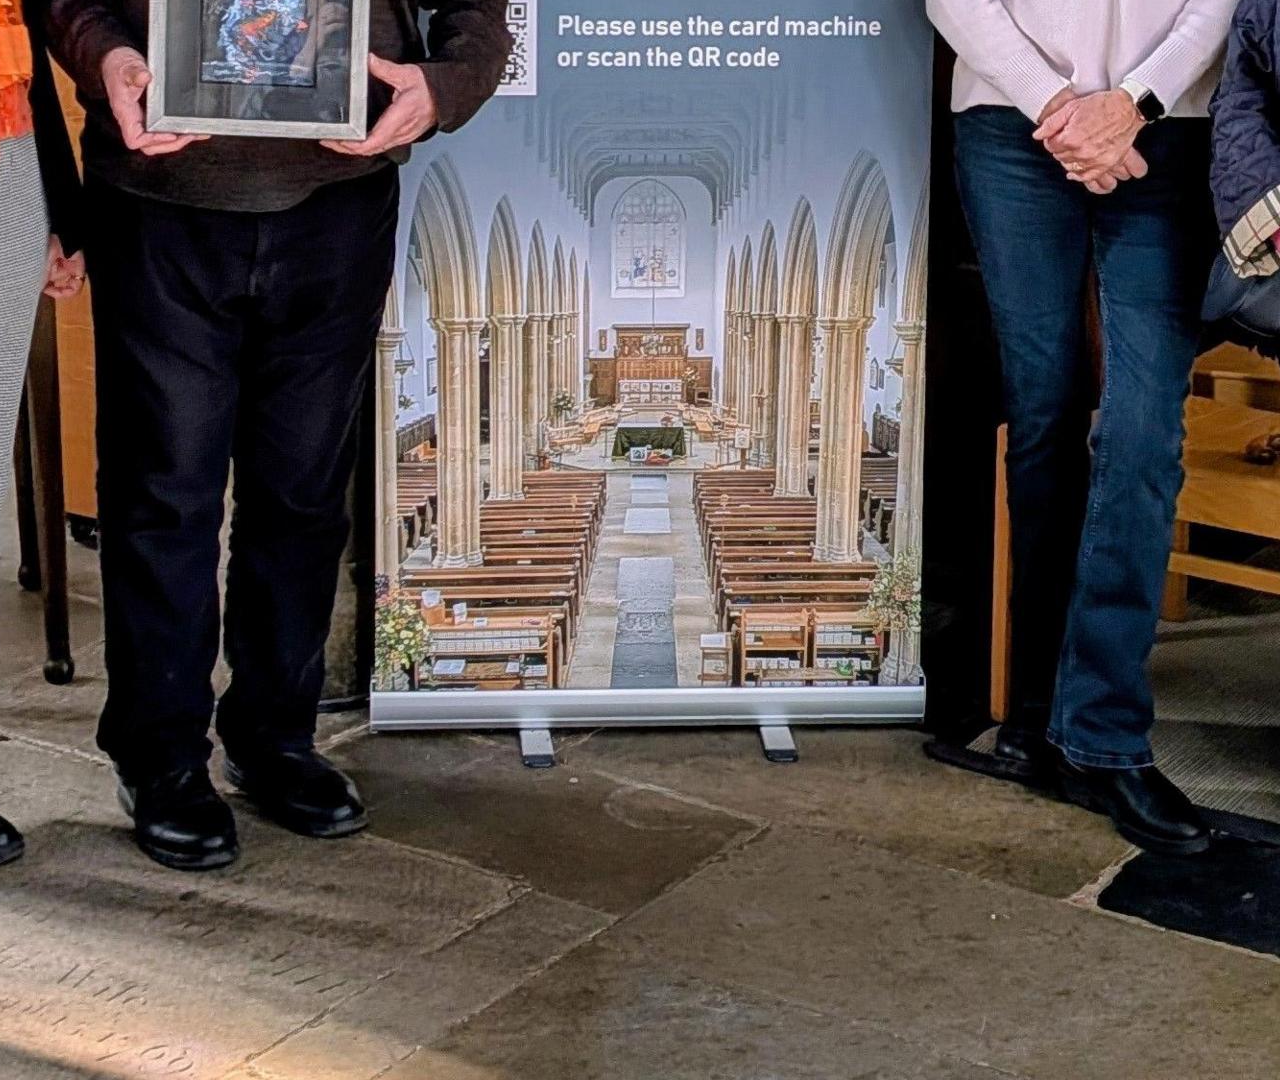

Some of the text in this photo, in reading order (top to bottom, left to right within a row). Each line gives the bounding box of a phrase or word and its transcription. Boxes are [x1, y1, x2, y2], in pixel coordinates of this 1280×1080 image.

[559, 16, 881, 35] Please use the card machine
[558, 47, 779, 66] or scan the QR code
